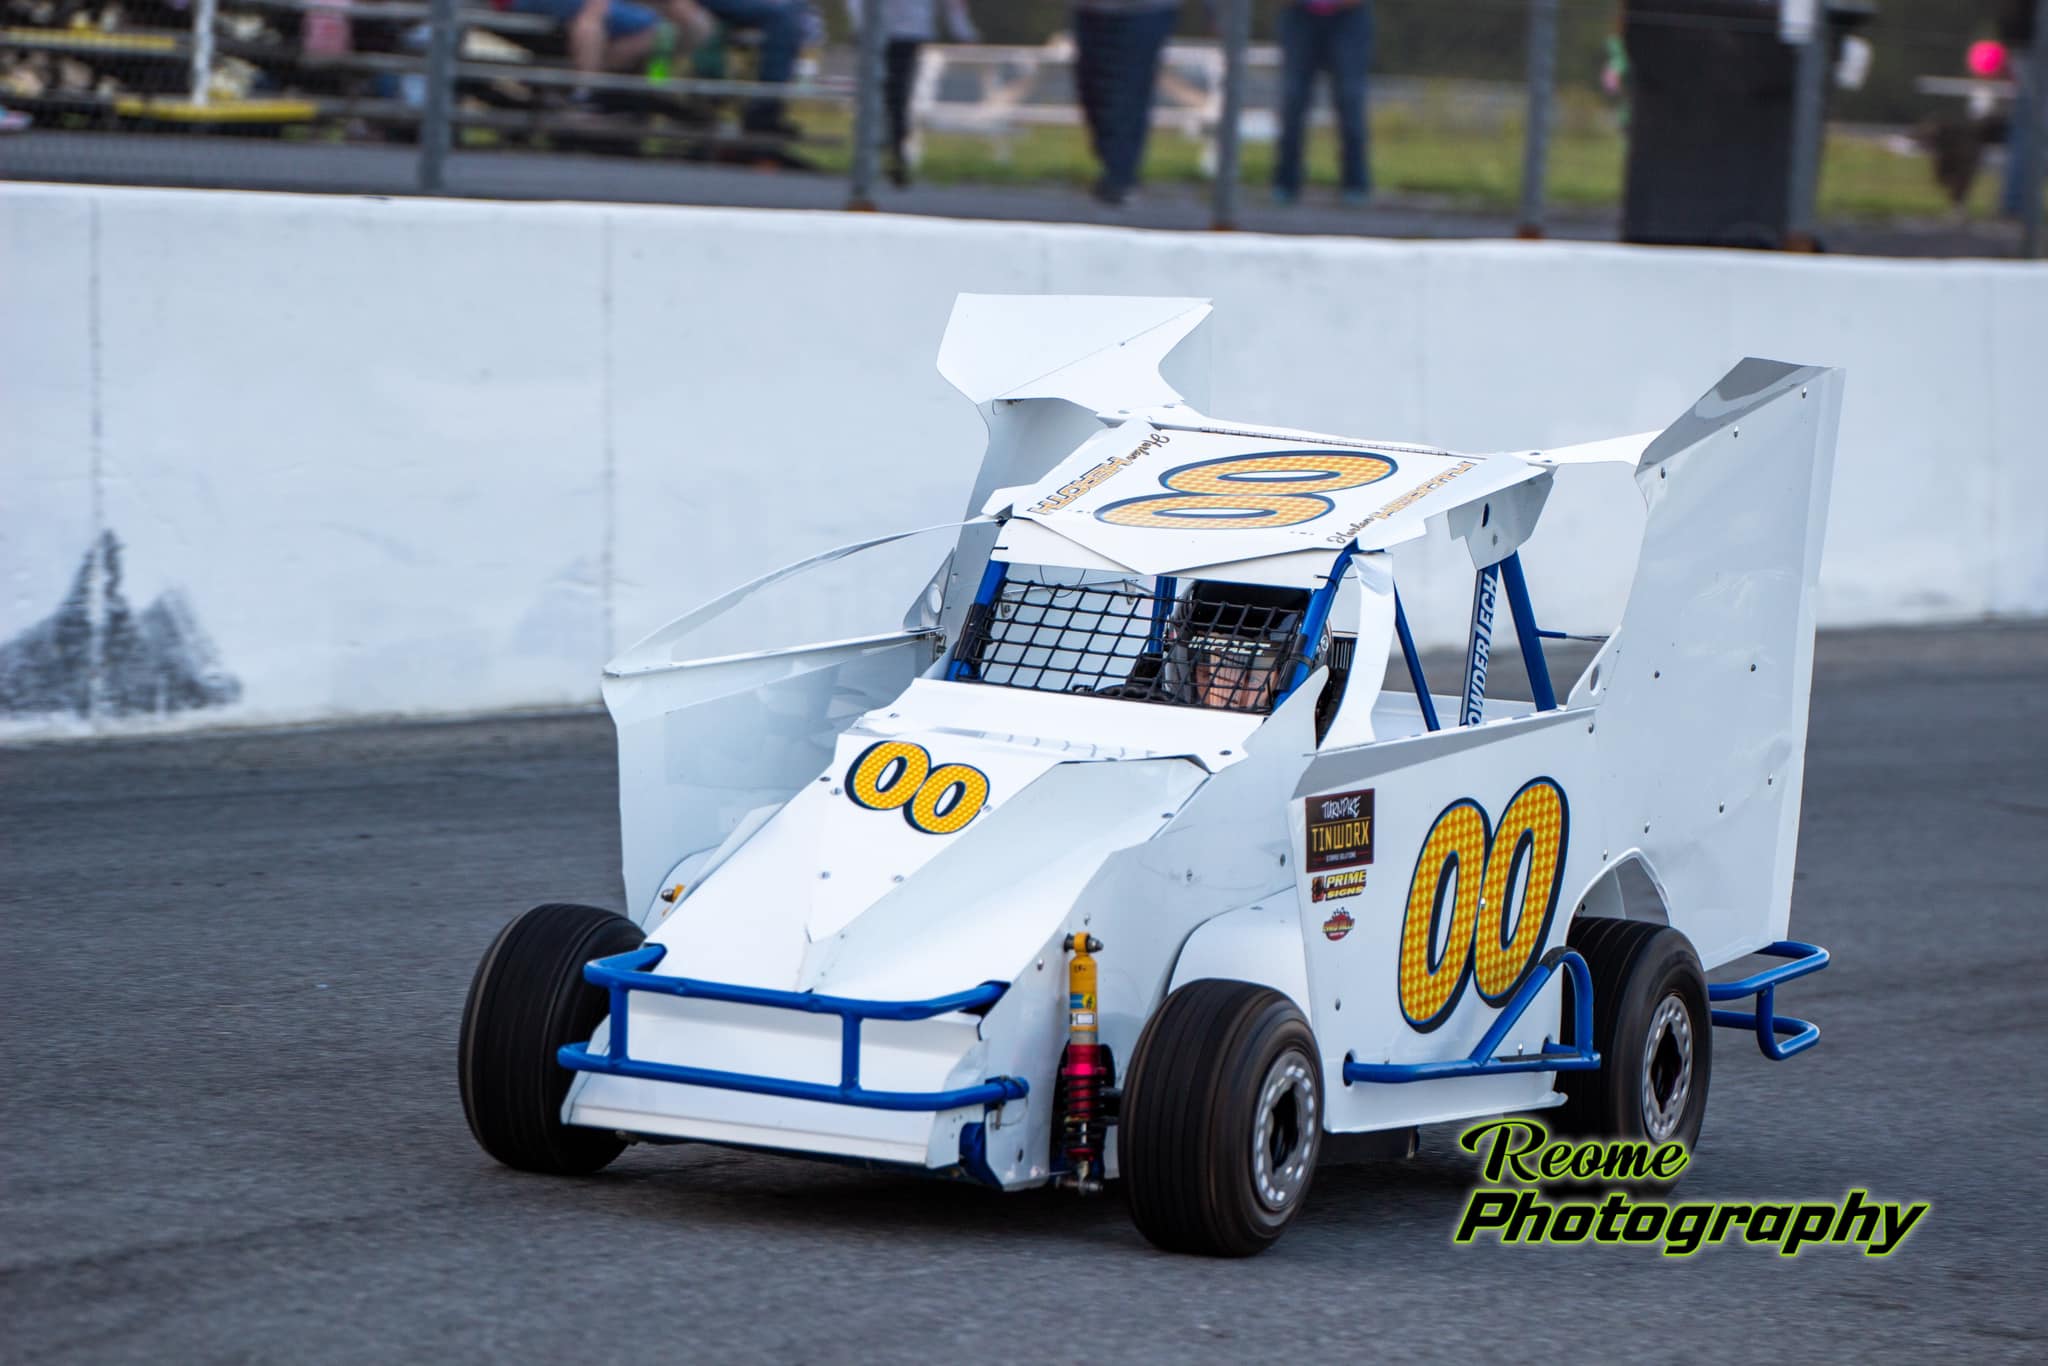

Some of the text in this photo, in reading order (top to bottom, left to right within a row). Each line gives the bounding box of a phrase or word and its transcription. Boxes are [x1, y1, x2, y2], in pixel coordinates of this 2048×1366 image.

[1093, 448, 1398, 530] 00
[1467, 572, 1498, 727] OWDERTECH
[844, 740, 990, 835] 00
[1311, 820, 1370, 852] TINWORX
[1326, 870, 1367, 889] PRIME
[1326, 885, 1364, 899] SIGNS
[1398, 776, 1570, 1034] 00
